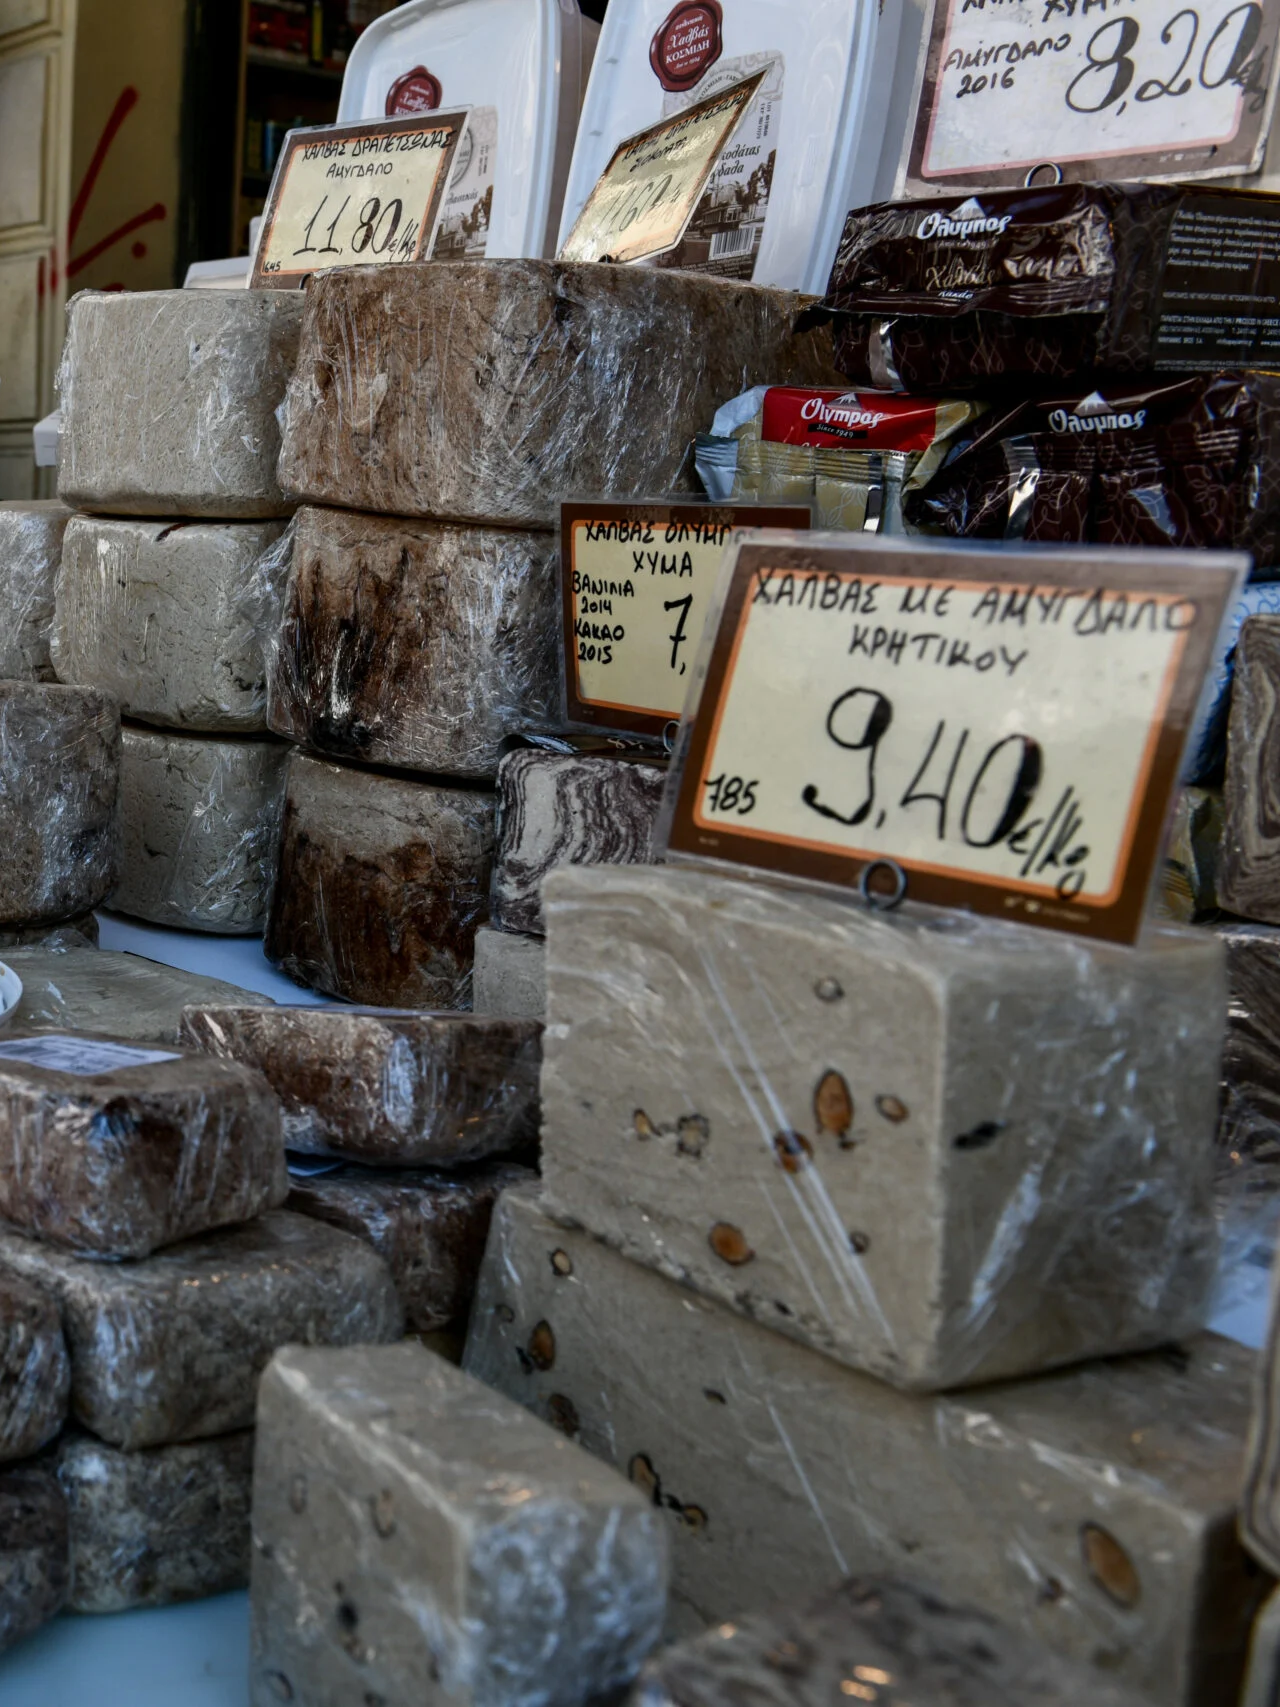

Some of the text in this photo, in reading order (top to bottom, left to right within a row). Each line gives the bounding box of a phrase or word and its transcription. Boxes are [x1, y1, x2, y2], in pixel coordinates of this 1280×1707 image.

[665, 39, 710, 65] ΚΟΣΜΙΔΗ
[956, 67, 1015, 98] 2016
[326, 162, 393, 179] ΑΜΥΓΔΑΛΟ
[801, 398, 884, 429] Olympos
[835, 429, 854, 438] 1949
[585, 520, 656, 543] ΧΑΛΒΑΣ
[633, 551, 693, 577] ΧΥΜΑ
[581, 596, 613, 616] 2014
[753, 567, 1201, 636] ΧΑΛΒΑΣ ΜΕ ΑΜΥΓΔΑΛΟ
[574, 618, 625, 641] ΚΑΚΑΟ
[578, 642, 613, 664] 2015
[849, 624, 1029, 676] ΚΡΗΤΙΚΟΥ
